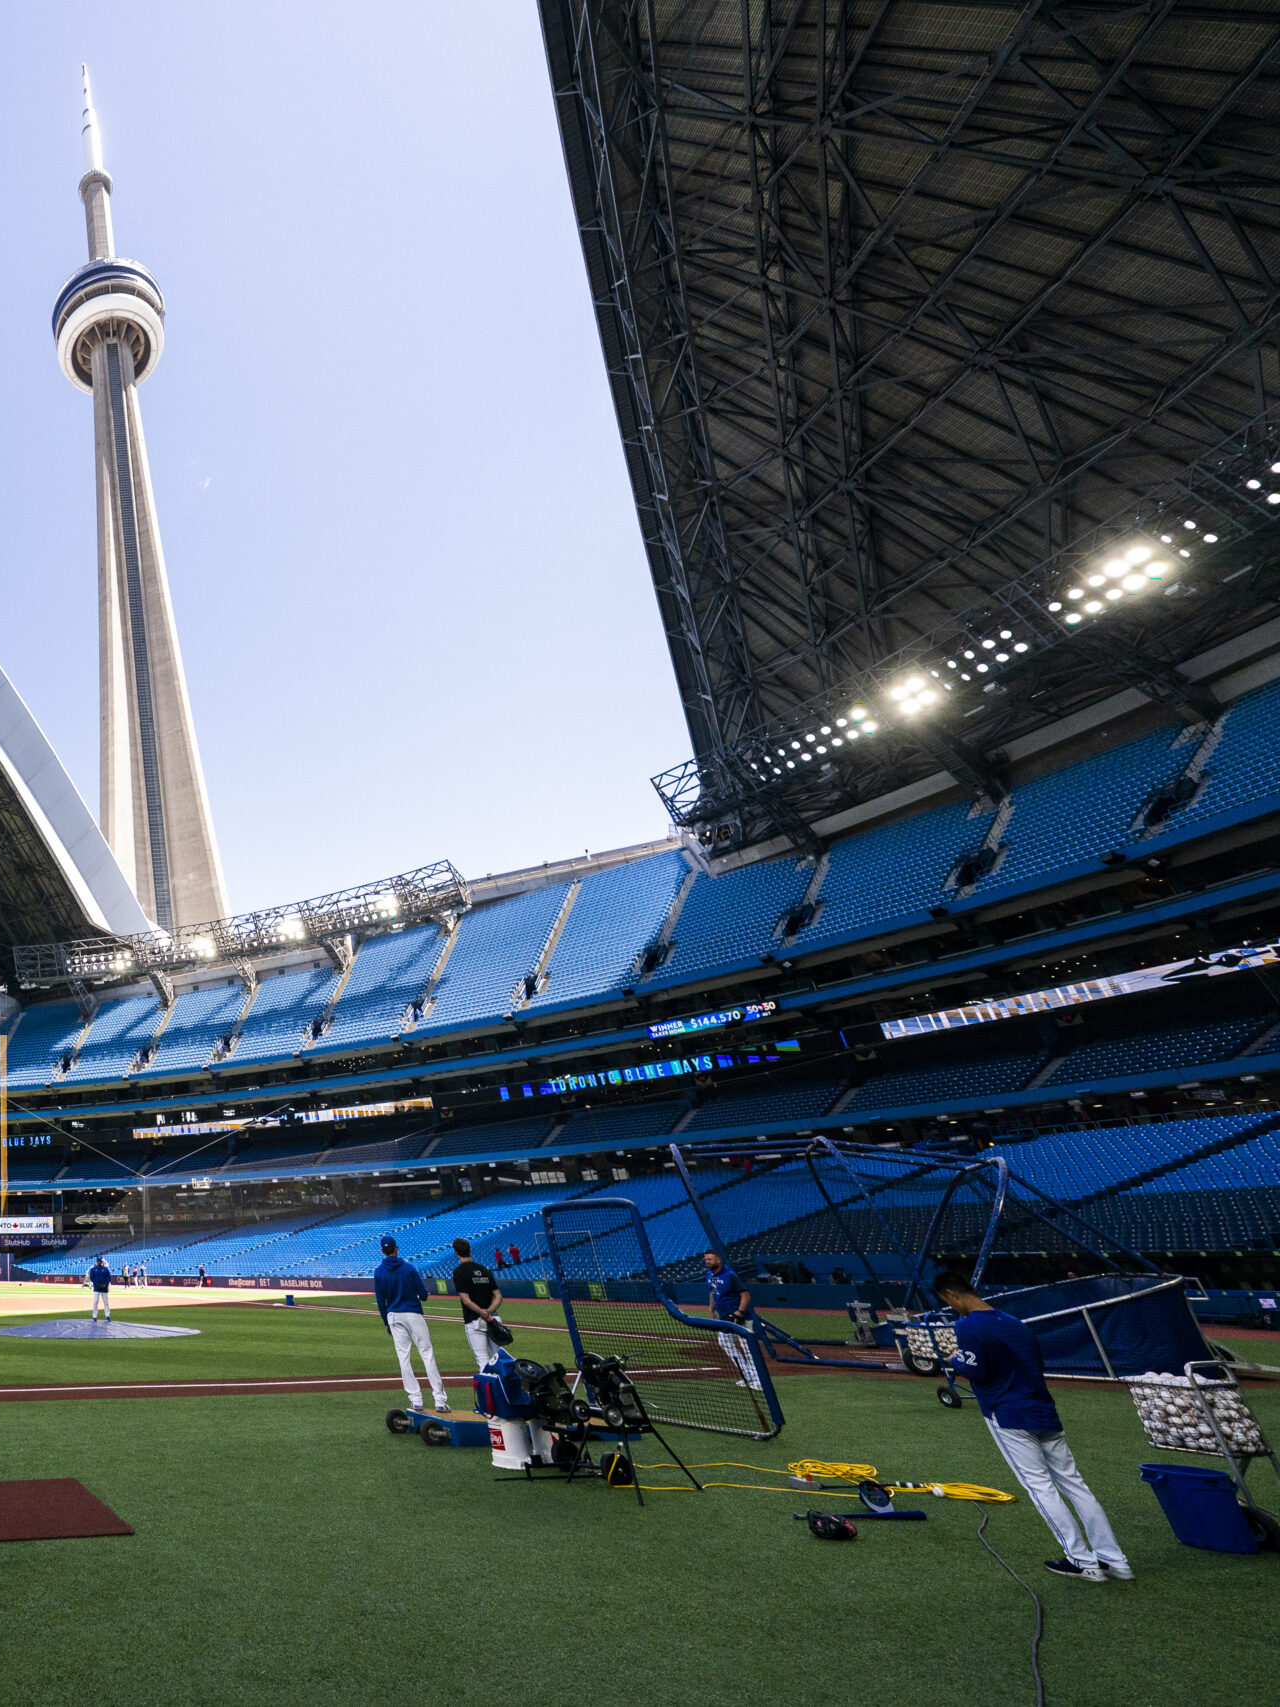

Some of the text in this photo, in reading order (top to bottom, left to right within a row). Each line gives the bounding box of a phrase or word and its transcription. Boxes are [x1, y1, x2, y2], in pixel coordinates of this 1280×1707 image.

[649, 1021, 684, 1033] WINNER
[690, 1010, 741, 1029] $144,570
[549, 1055, 713, 1092] TORONTO BLUE JAYS
[2, 1137, 25, 1147] BLUE
[29, 1135, 51, 1146] JAYS
[41, 1238, 67, 1246] StubHub
[228, 1278, 323, 1288] theScore BET BASELINE BOX
[534, 1284, 546, 1295] TD
